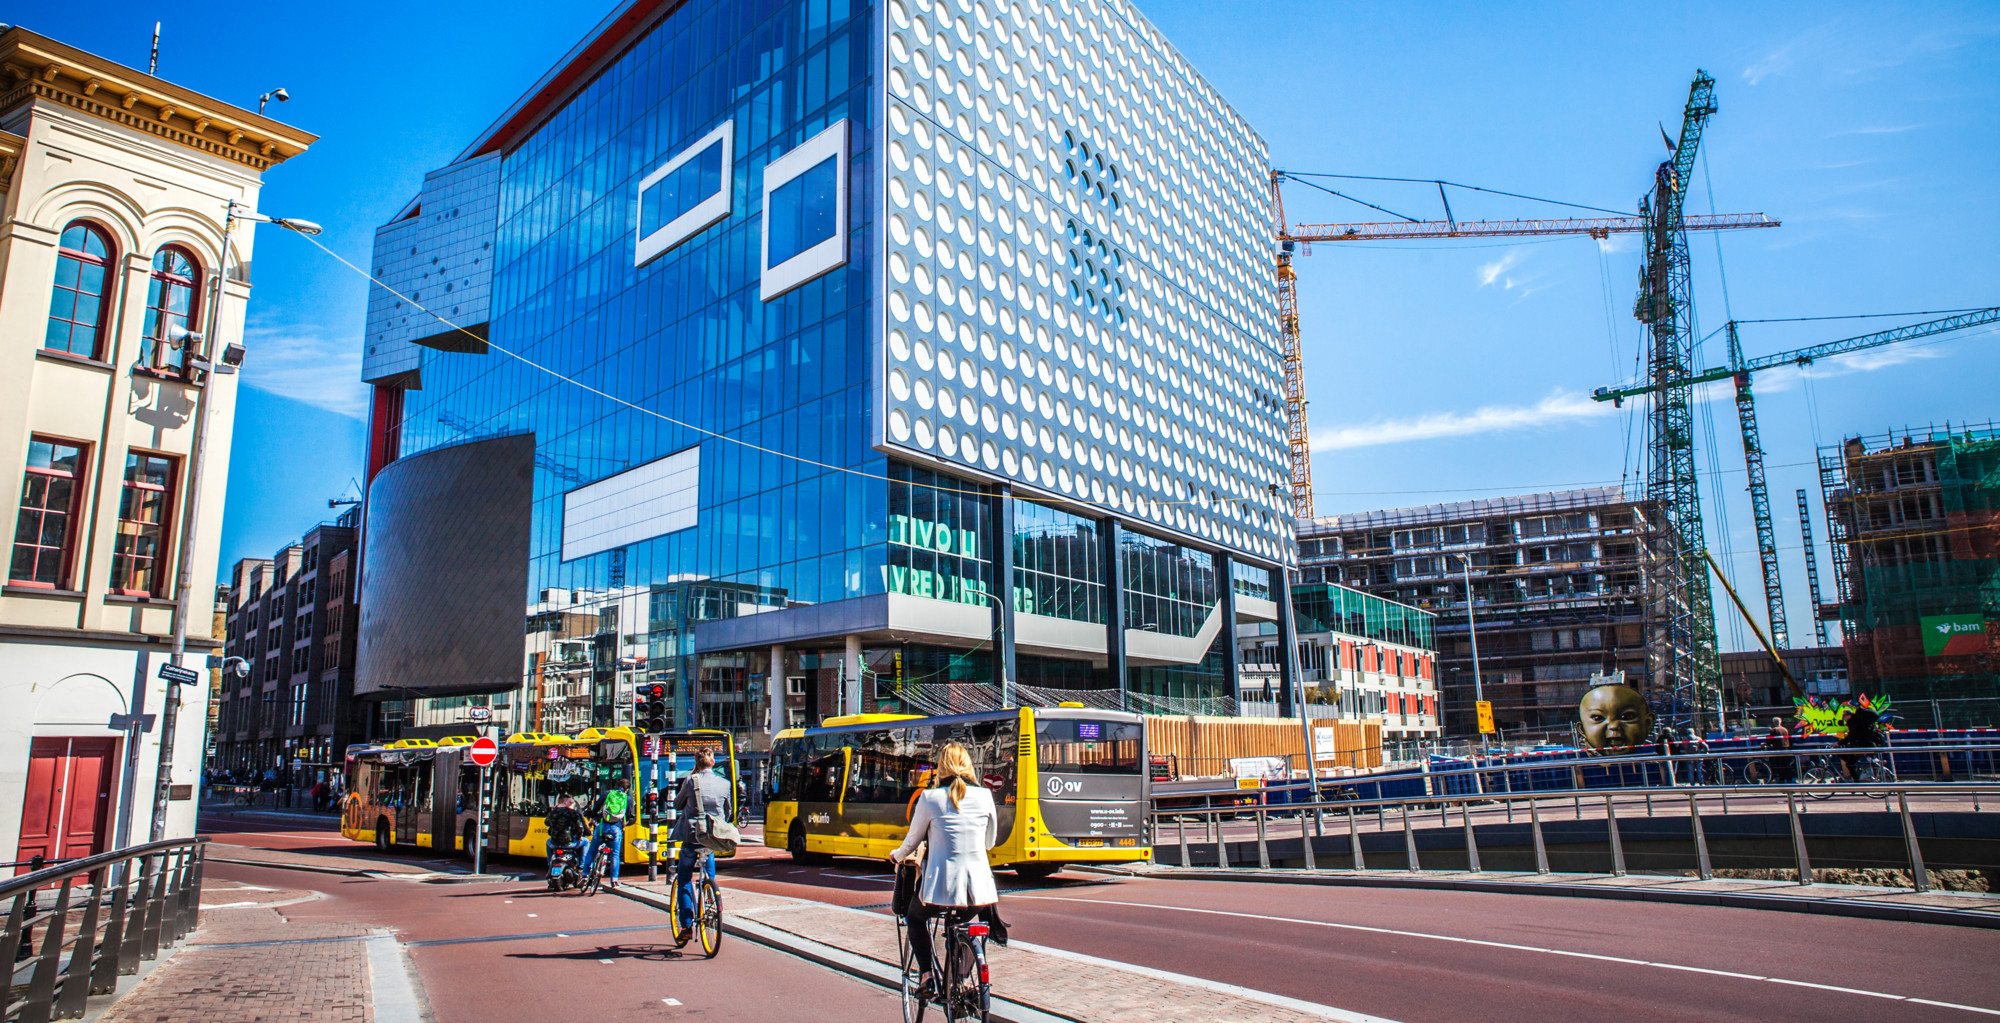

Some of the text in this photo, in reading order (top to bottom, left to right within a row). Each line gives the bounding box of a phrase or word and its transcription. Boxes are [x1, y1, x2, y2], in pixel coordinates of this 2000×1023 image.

[895, 514, 976, 558] TIVOLI
[889, 565, 1033, 614] VREDENBRG
[1952, 622, 1980, 631] bam
[1064, 781, 1082, 792] OV
[1119, 838, 1136, 846] 4443
